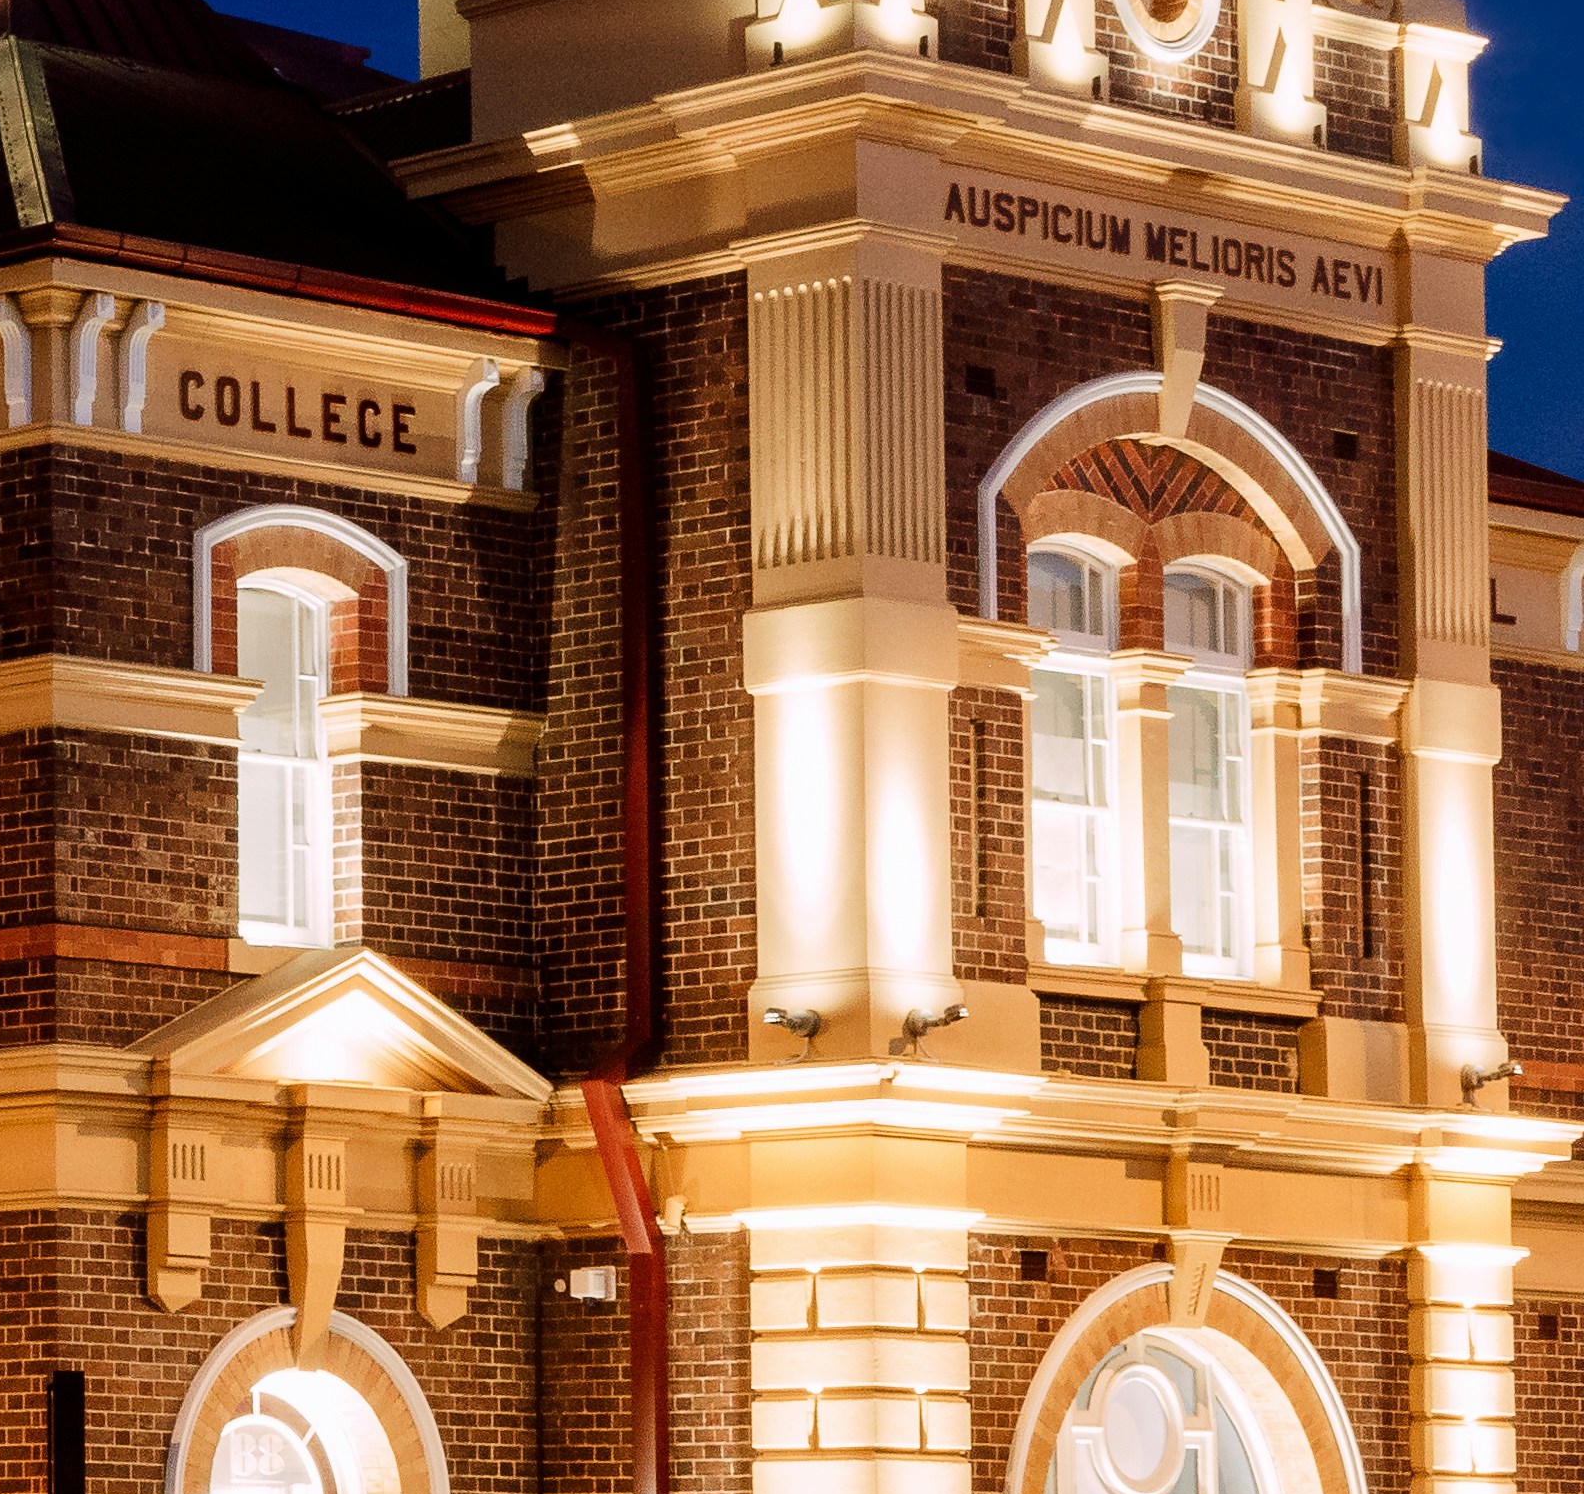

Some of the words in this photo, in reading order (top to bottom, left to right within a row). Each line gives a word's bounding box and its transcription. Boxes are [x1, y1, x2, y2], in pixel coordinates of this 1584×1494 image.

[945, 182, 1132, 256] AUSPICIUM
[1144, 221, 1296, 287] MELIORIS
[1311, 255, 1384, 305] AEVI
[178, 369, 418, 455] COLLEGE
